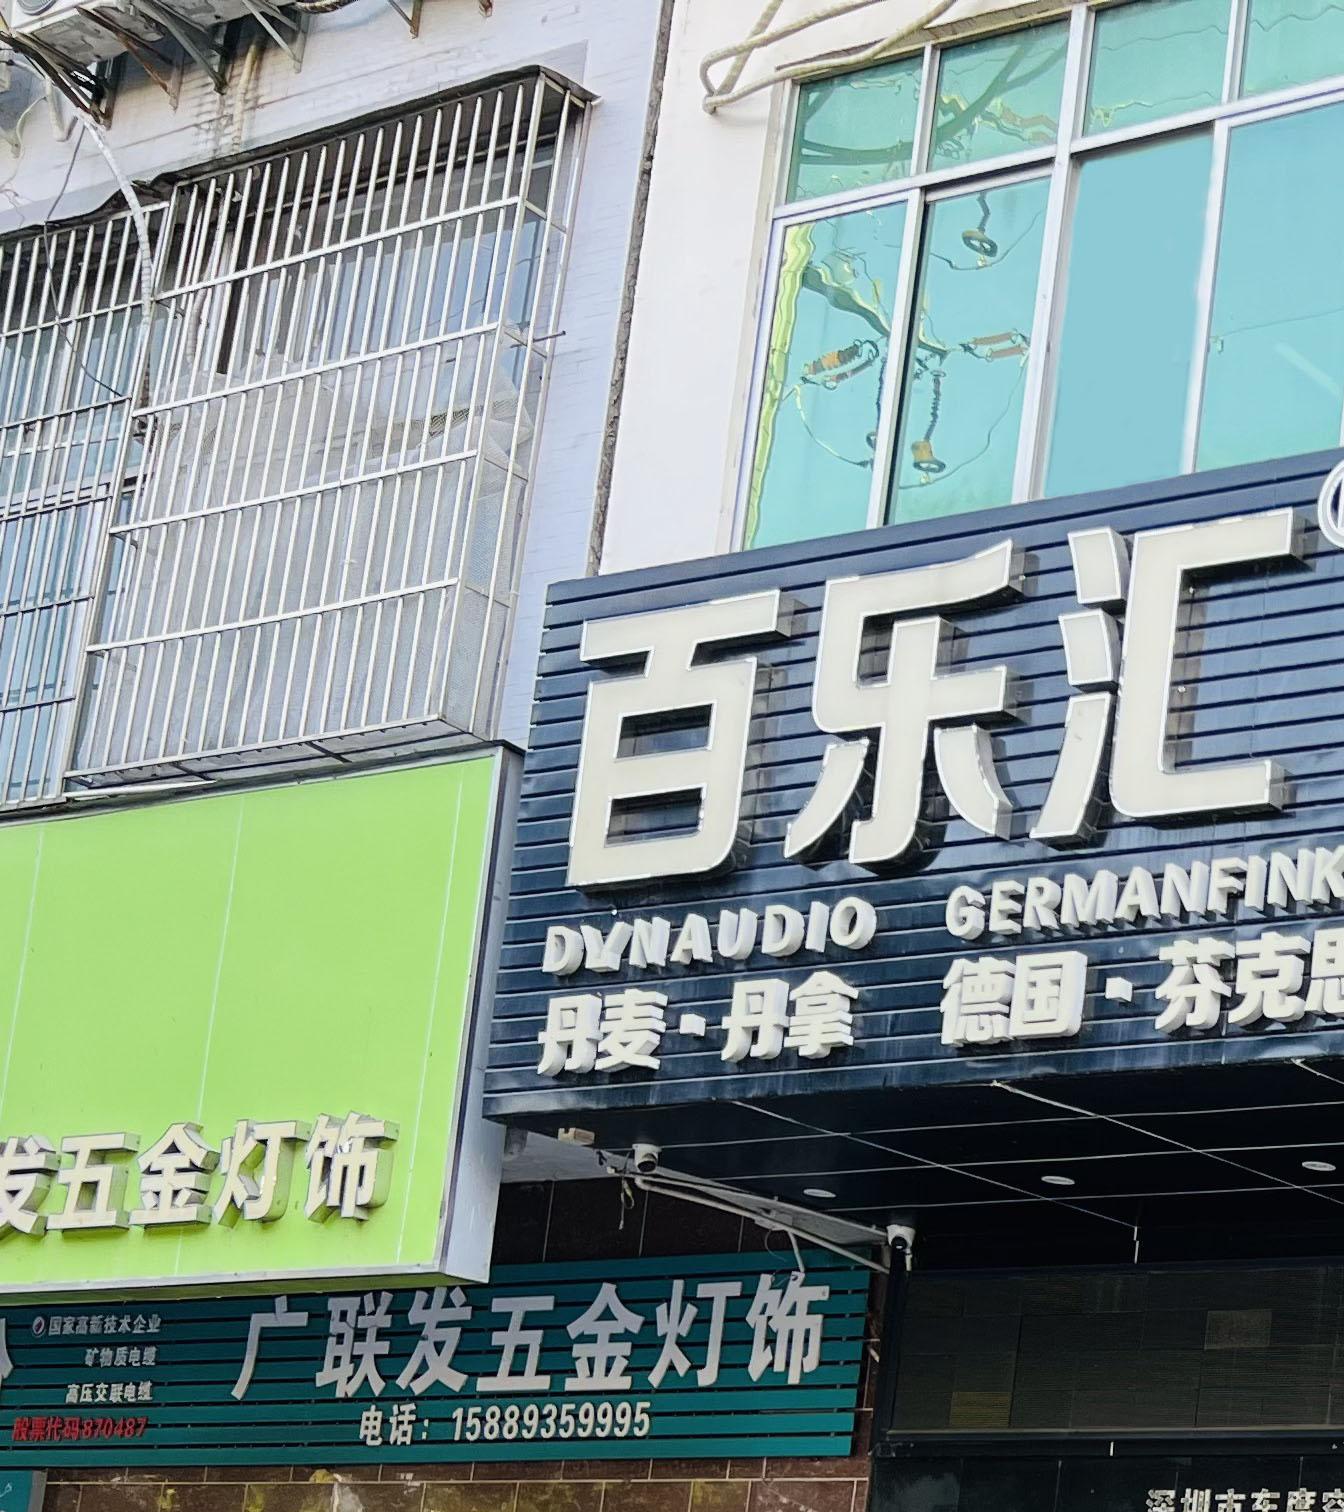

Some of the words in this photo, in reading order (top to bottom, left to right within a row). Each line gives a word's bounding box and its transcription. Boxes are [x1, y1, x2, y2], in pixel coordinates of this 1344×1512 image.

[566, 506, 1304, 888] 百乐汇
[542, 895, 878, 978] DYNAUDIO
[48, 1313, 162, 1336] 国家高新技术企业
[231, 1270, 830, 1400] 广联发五金灯饰
[84, 1345, 157, 1368] 矿物质电缆
[65, 1380, 153, 1404] 高压交联电缆
[11, 1416, 149, 1442] 股票代码870487
